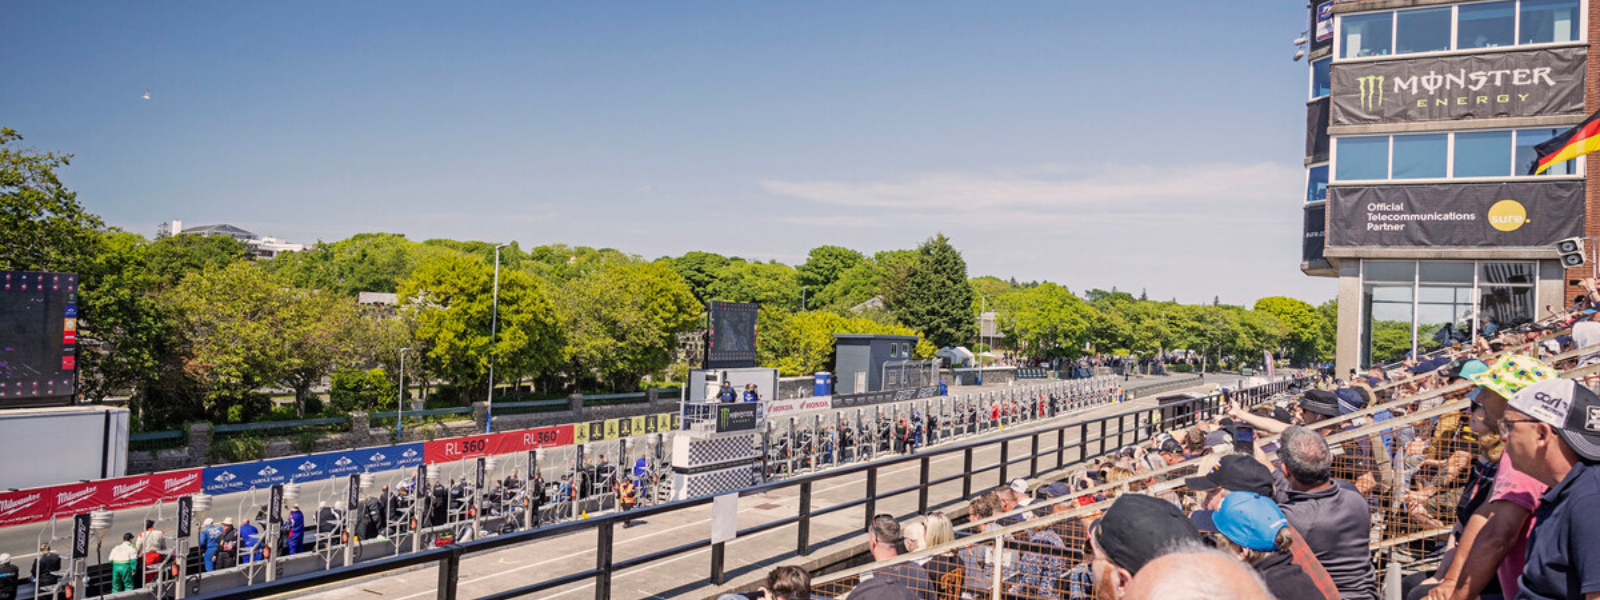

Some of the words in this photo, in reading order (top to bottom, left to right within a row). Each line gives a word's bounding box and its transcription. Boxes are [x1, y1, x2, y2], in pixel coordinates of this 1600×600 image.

[1393, 67, 1556, 95] MONSTER
[1417, 93, 1530, 107] ENERGY
[1367, 203, 1404, 211] Official
[1367, 212, 1475, 221] Telecommunications
[1367, 222, 1406, 232] Partner
[772, 404, 794, 412] HONDA
[806, 401, 829, 409] HONDA
[163, 472, 198, 490] Milwaukee
[112, 478, 150, 498] Milwaukee
[56, 485, 97, 505] Milwaukee
